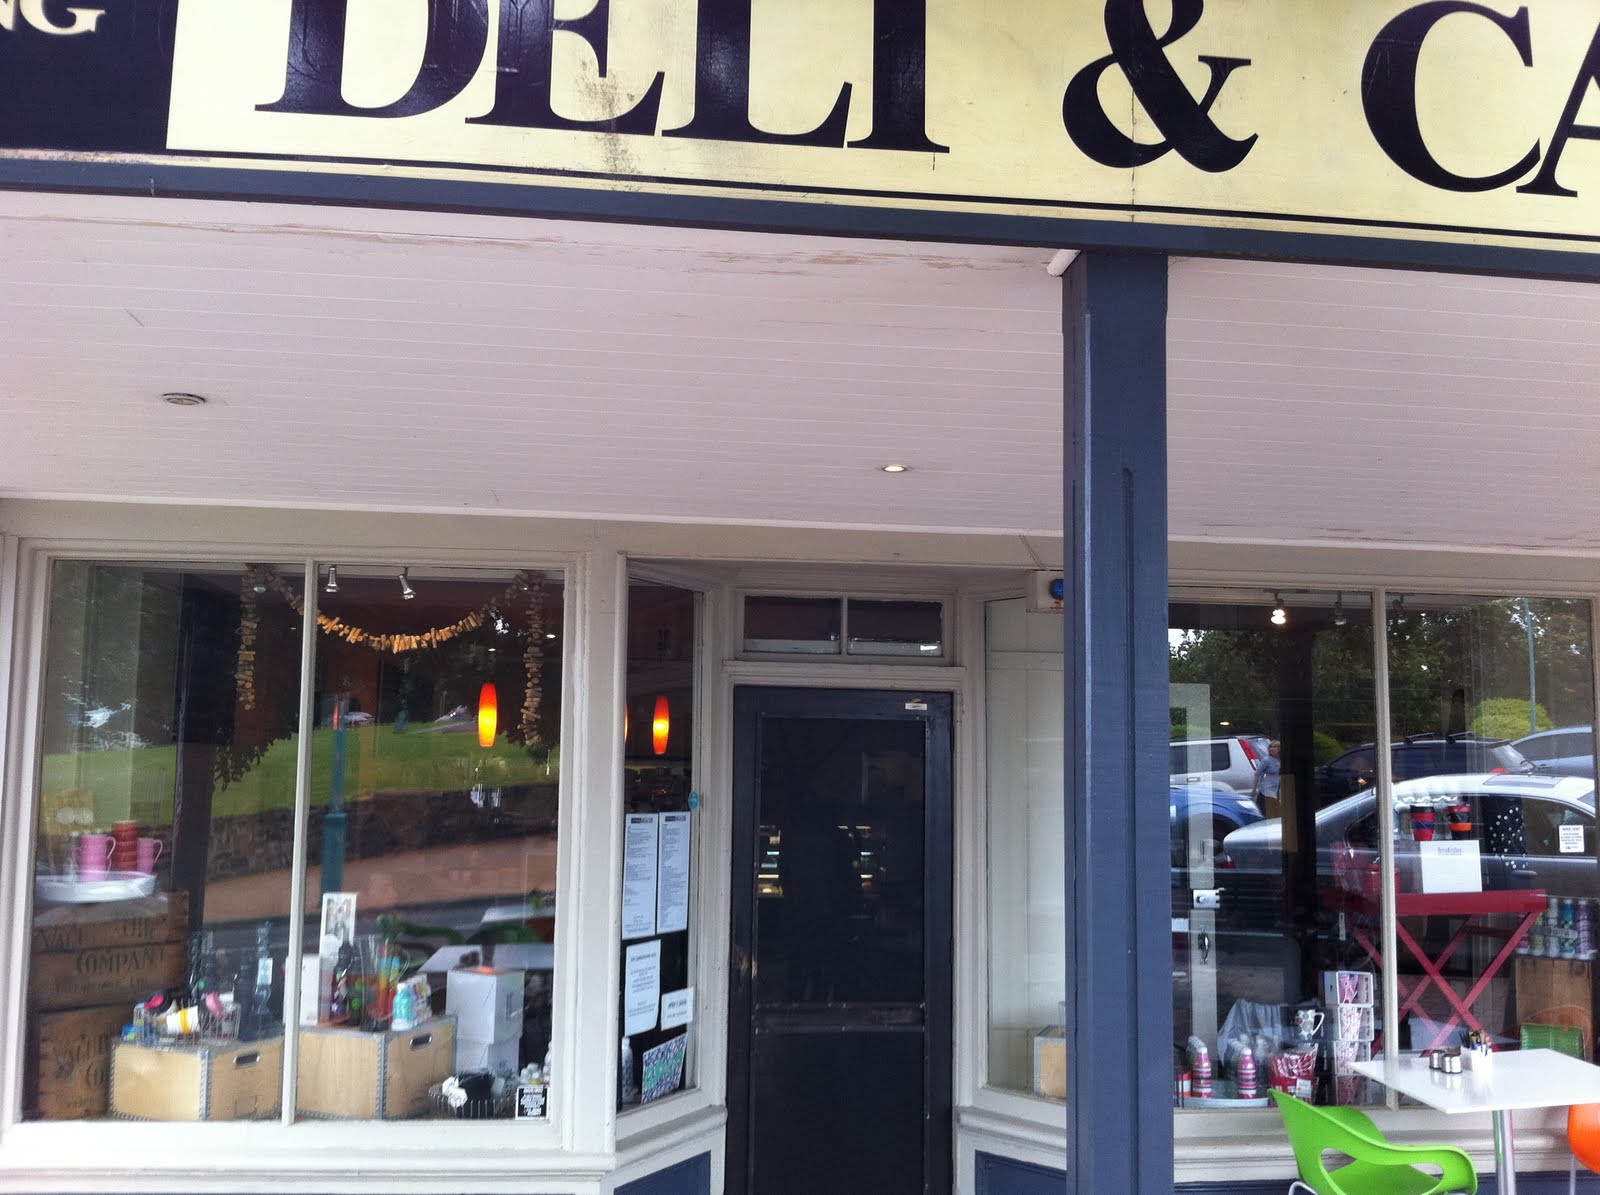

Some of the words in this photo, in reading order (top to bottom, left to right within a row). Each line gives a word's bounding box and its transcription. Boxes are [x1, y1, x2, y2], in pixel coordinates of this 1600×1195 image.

[0, 0, 106, 35] G
[255, 0, 949, 153] DELI
[1062, 0, 1259, 173] &
